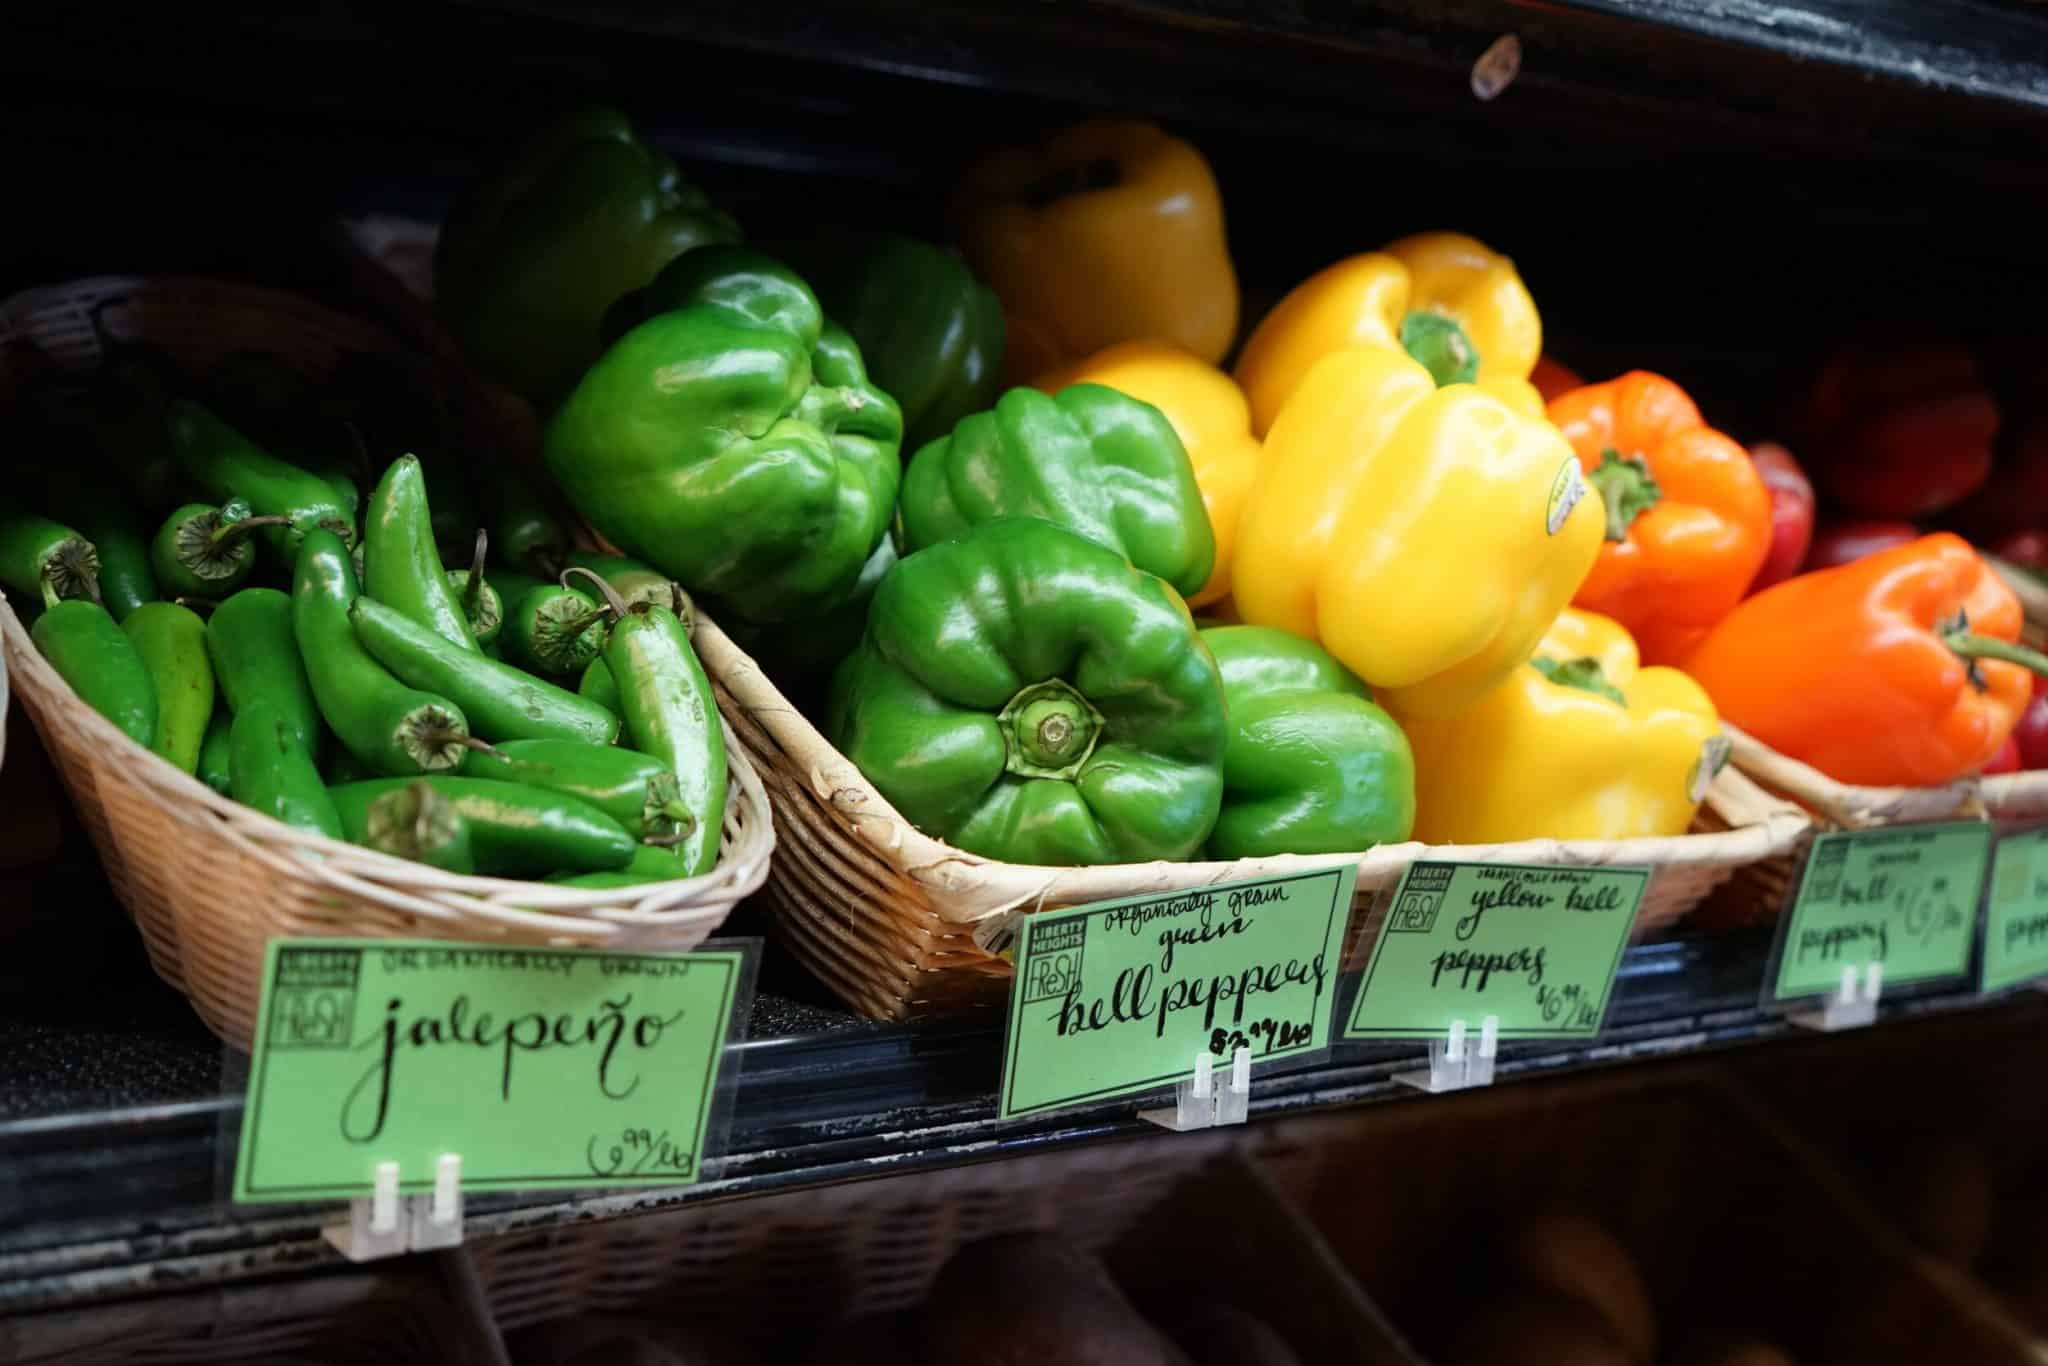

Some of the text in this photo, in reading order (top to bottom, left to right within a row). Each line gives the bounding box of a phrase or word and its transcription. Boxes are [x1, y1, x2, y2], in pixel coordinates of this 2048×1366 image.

[1104, 891, 1219, 936] organically
[1455, 879, 1625, 941] yellow bell
[1047, 963, 1154, 1036] bell
[1430, 947, 1549, 992] peppers
[340, 992, 685, 1144] jalepeño
